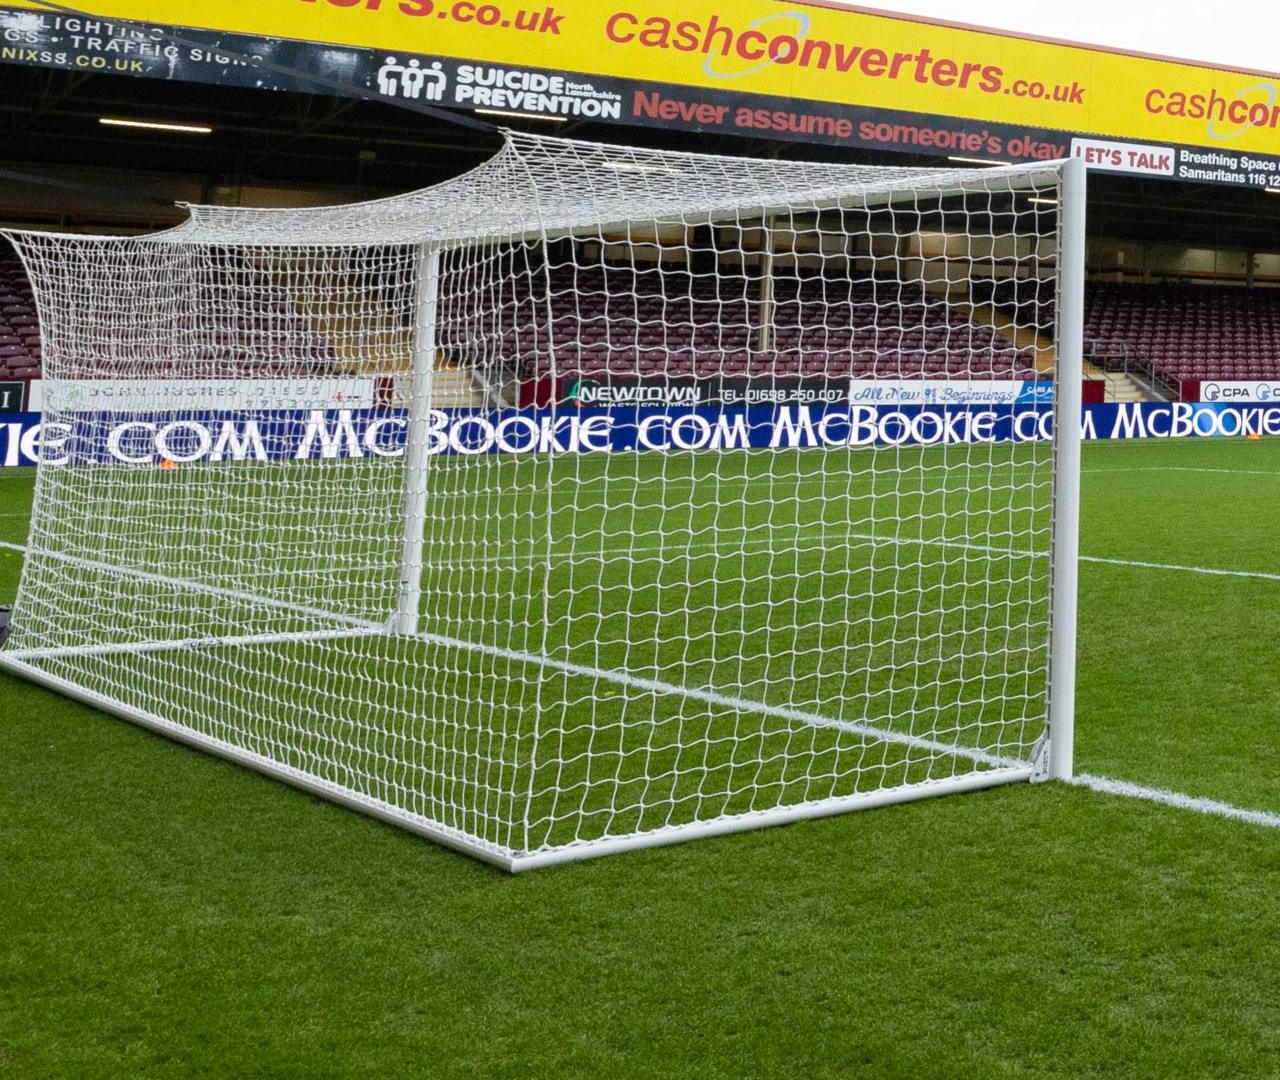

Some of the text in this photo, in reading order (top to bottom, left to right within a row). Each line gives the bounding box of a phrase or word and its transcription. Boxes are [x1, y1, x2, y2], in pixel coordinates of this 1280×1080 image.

[70, 35, 180, 60] TRAFFIC
[605, 12, 1085, 106] cashconverters.co.uk
[456, 64, 564, 94] SUICIDE
[566, 81, 594, 91] North
[455, 85, 621, 119] PREVENTION
[632, 90, 728, 125] Never
[735, 106, 852, 138] assume
[859, 120, 1001, 154] someone's
[1128, 151, 1170, 171] TALK
[1180, 149, 1238, 169] Breathing
[1240, 156, 1276, 174] Space
[1179, 165, 1246, 184] Samaritans
[1248, 173, 1265, 186] 116
[580, 386, 701, 401] NEWTOWN
[855, 387, 920, 400] All New
[940, 387, 1013, 404] Beginnings
[1222, 387, 1250, 397] CPA
